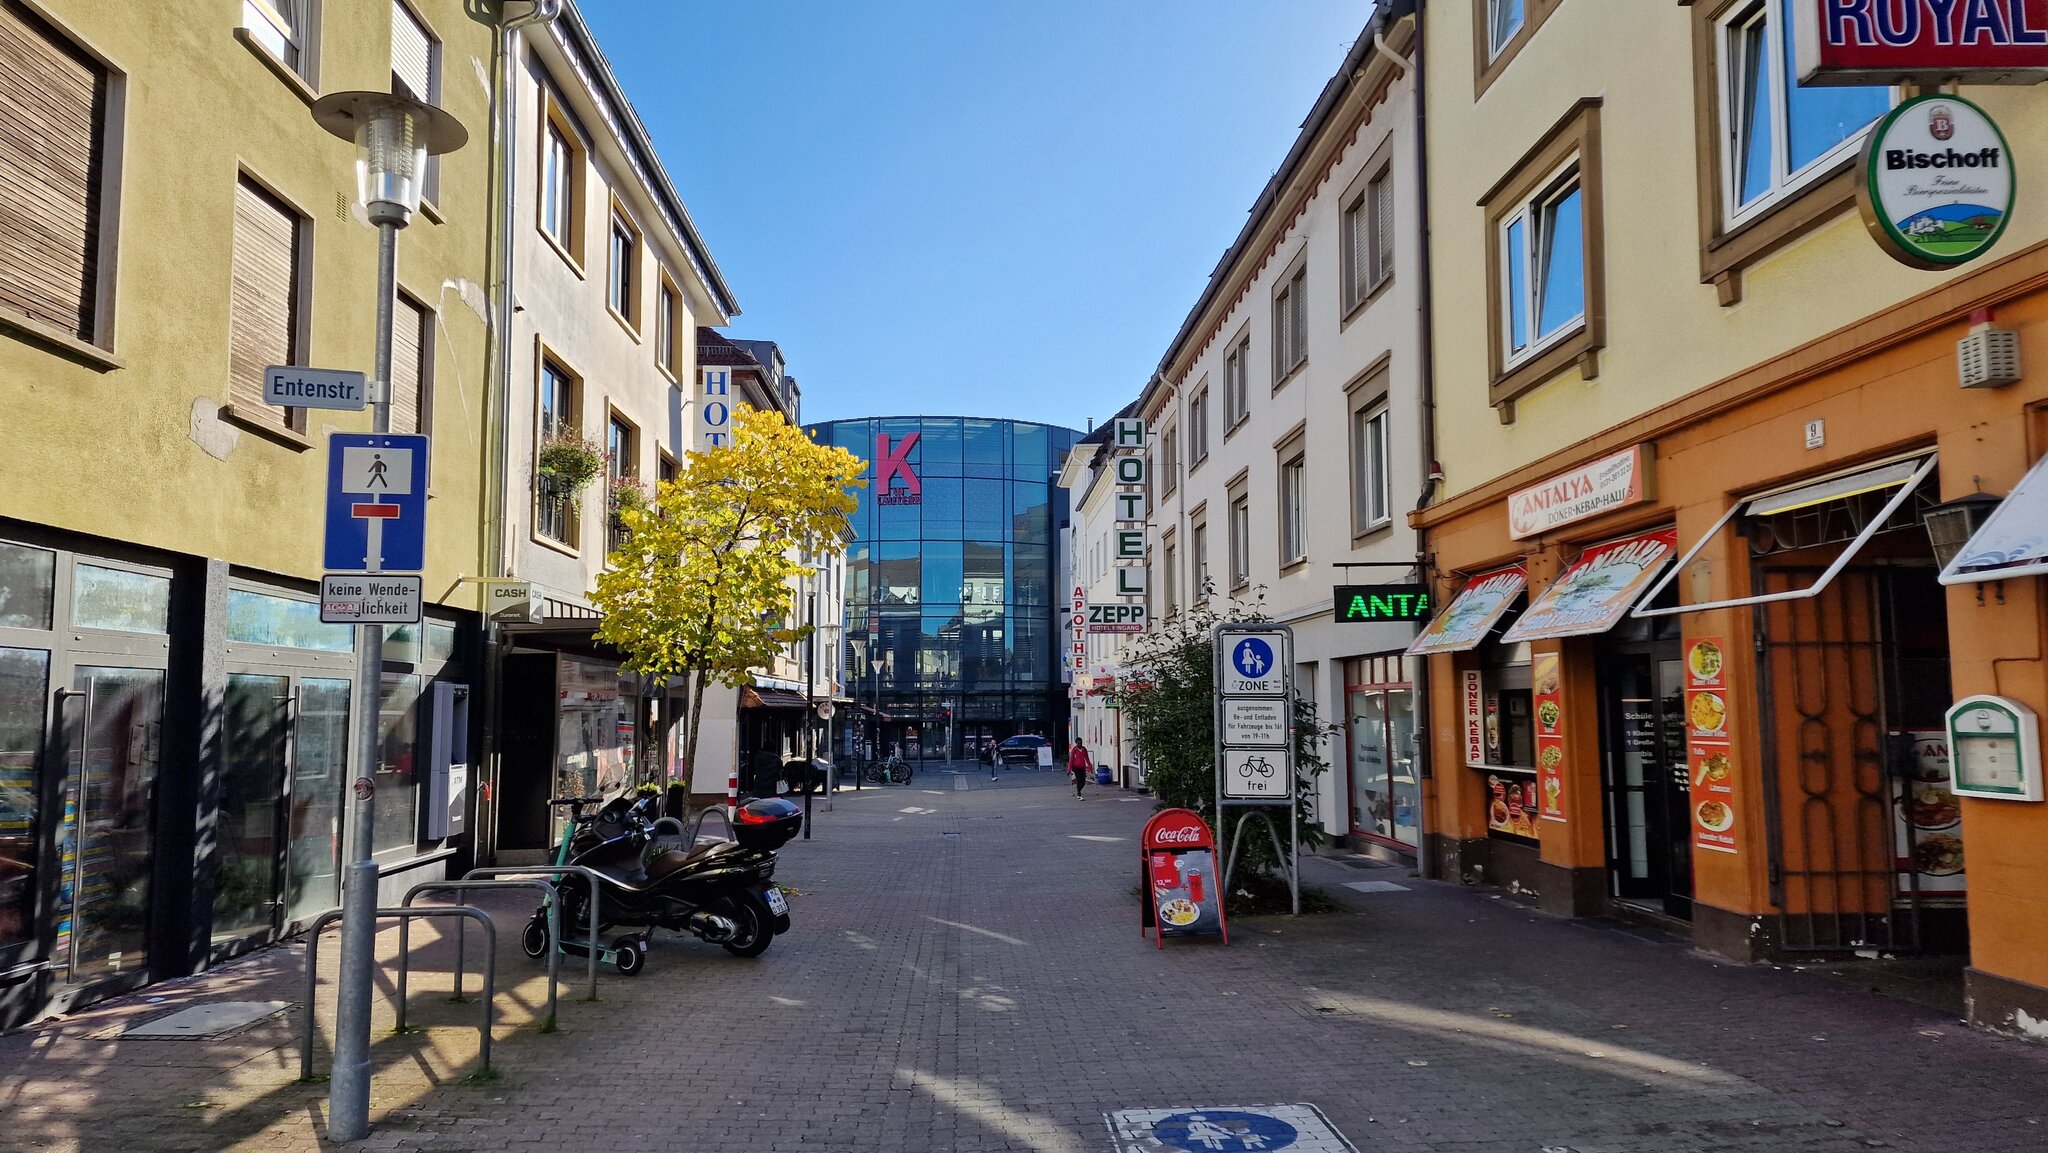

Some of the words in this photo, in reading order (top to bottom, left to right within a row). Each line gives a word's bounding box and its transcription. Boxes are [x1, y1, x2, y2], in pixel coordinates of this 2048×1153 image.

[1827, 0, 2048, 46] ROYAL
[1886, 148, 1999, 170] Bischoff
[273, 375, 360, 401] Entenstr.
[1810, 423, 1817, 438] 9
[876, 433, 921, 495] K
[1119, 421, 1143, 592] HOTEL
[1523, 473, 1594, 516] ANTALYA
[329, 583, 362, 596] keine
[369, 583, 416, 596] Wende-
[495, 589, 527, 597] CASH
[1089, 606, 1144, 623] ZEPP
[1347, 594, 1428, 618] ANTA
[1073, 587, 1085, 697] APOTHEE
[1238, 681, 1269, 691] ZONE
[1467, 673, 1478, 715] DÖNER
[1469, 720, 1480, 761] KEBAP
[1247, 781, 1267, 790] frei
